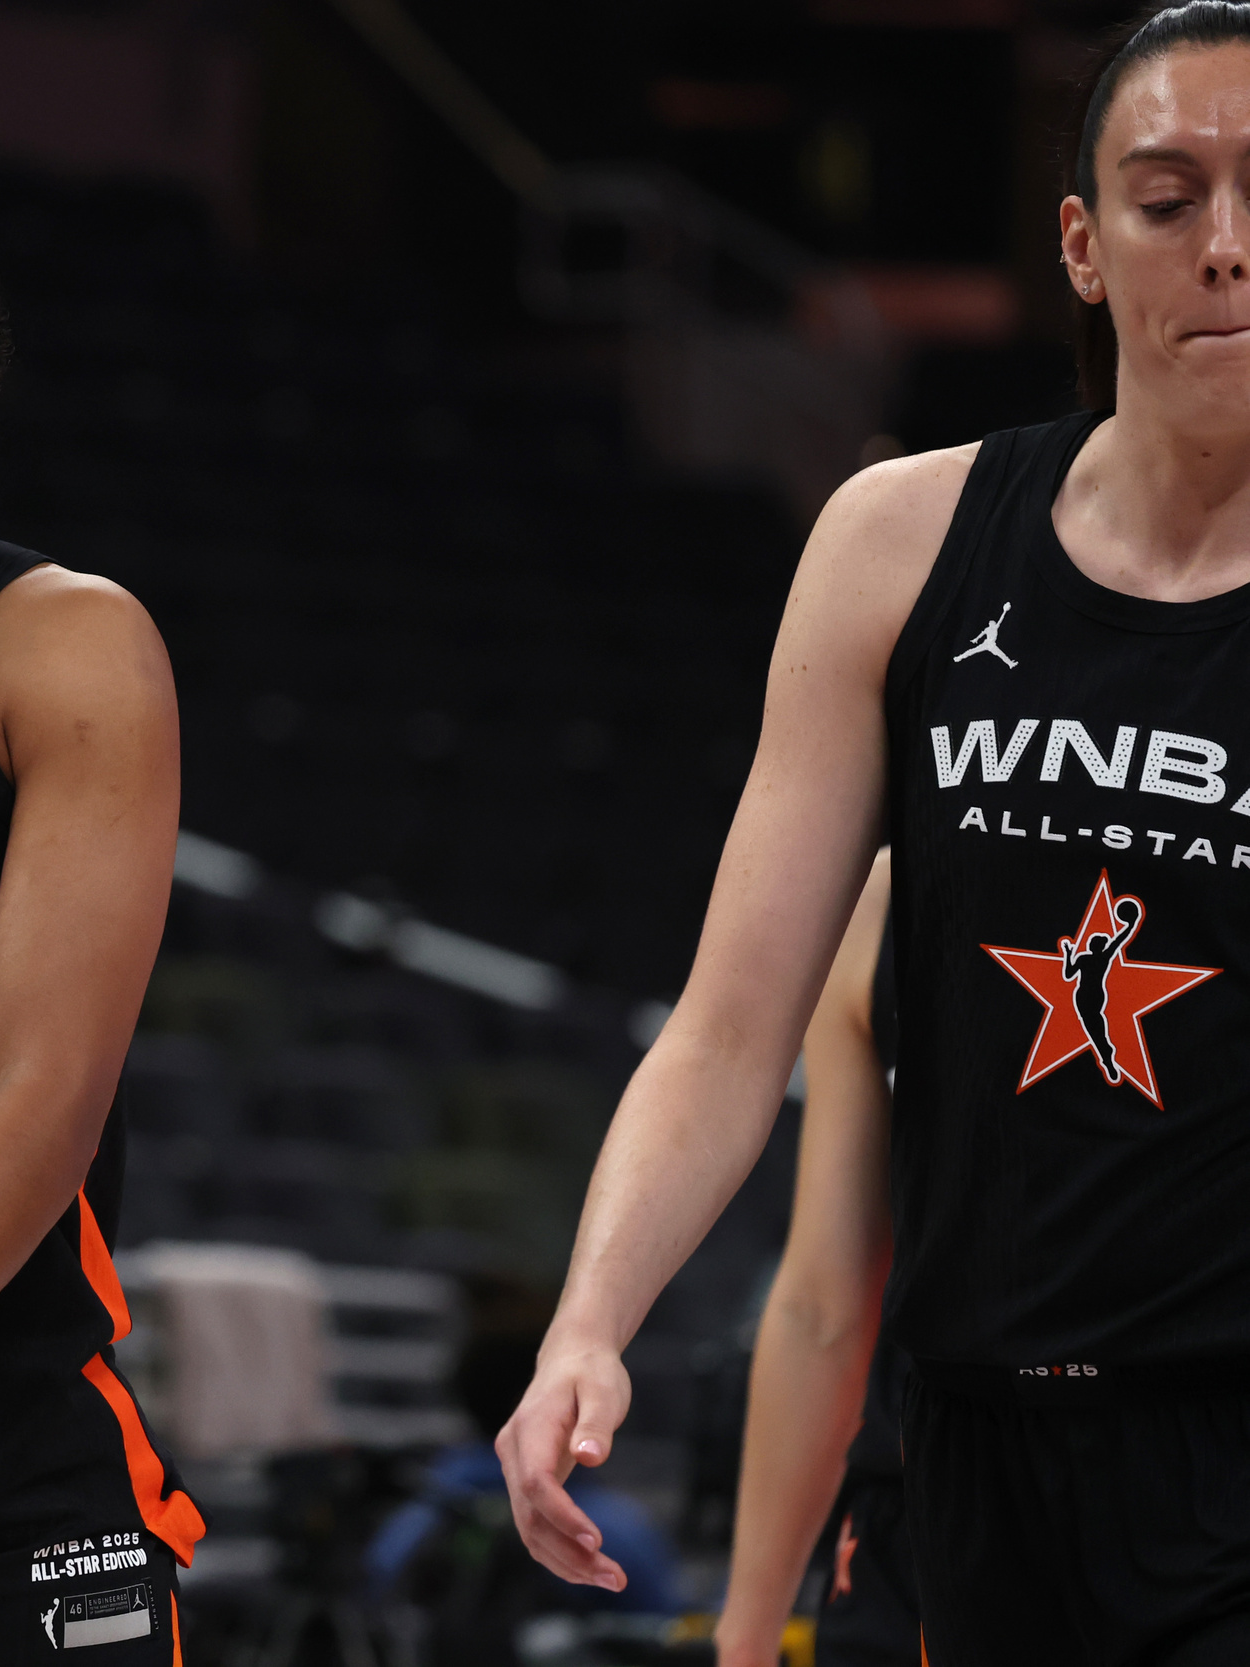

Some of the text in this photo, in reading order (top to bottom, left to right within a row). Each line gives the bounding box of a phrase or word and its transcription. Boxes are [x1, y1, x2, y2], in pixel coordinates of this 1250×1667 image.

[930, 718, 1250, 817] WNB
[1066, 1363, 1098, 1377] 25
[33, 1532, 140, 1559] WNBA 2025
[31, 1548, 148, 1582] ALL-STAR EDITION
[69, 1603, 83, 1615] 46
